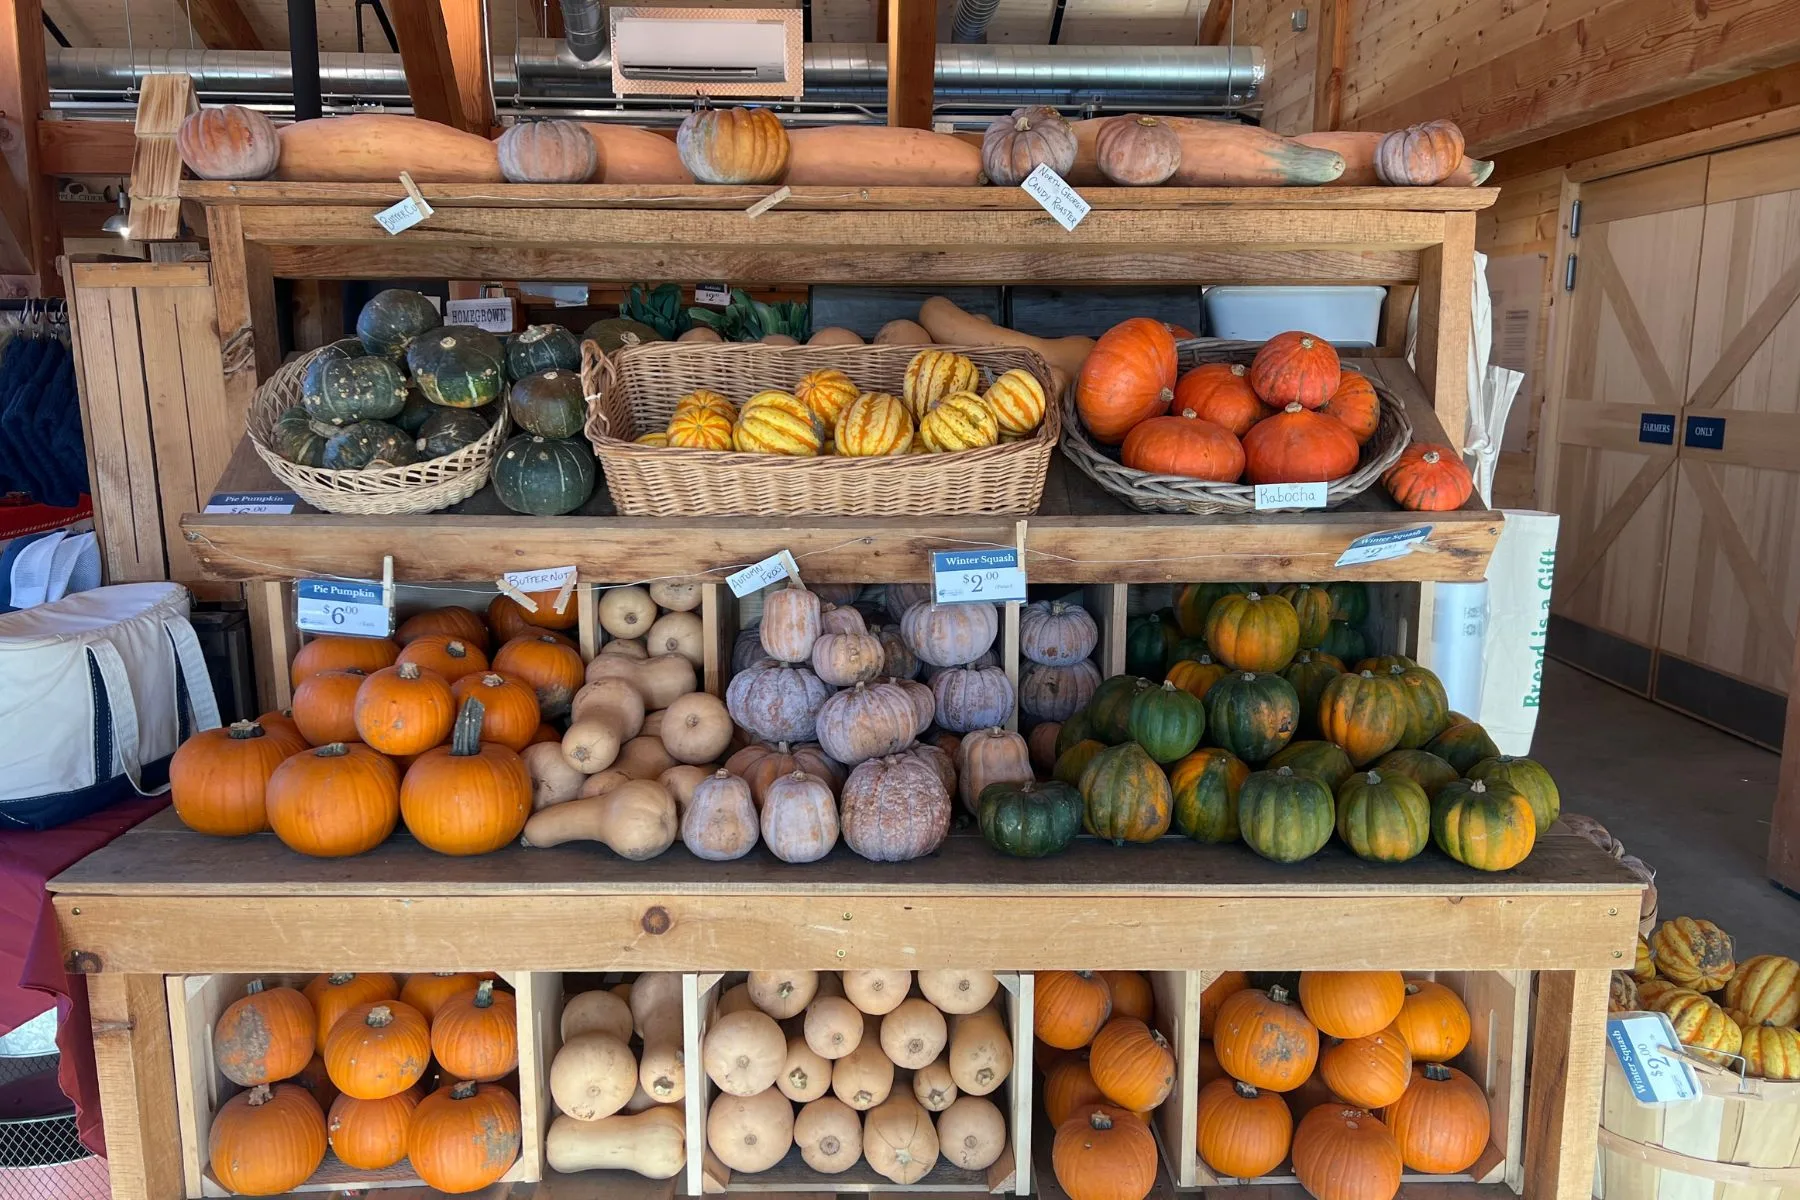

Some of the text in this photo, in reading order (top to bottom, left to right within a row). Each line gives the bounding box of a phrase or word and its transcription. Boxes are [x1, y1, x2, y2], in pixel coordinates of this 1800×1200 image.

[1038, 166, 1086, 214] NORTH GEORGIA
[1027, 176, 1077, 227] CANDY ROASTER
[379, 203, 418, 231] BUTTERCU
[451, 308, 507, 324] HOMEGROWN
[1642, 423, 1671, 433] FARMERS
[1694, 426, 1715, 437] ONLY
[241, 495, 284, 503] Pumpkin
[1260, 486, 1317, 505] Kabocha
[1361, 529, 1422, 545] Winter Squash
[945, 553, 1015, 567] Winter Squash
[1538, 548, 1556, 591] Gift
[731, 564, 764, 589] AUTUMN
[760, 561, 786, 585] FROST
[963, 571, 999, 593] $2.00
[313, 584, 375, 599] Pie Pumpkin
[322, 604, 359, 625] $6.00
[1531, 619, 1549, 637] is
[1523, 645, 1546, 708] Bread
[1612, 1029, 1647, 1094] Winter Squash
